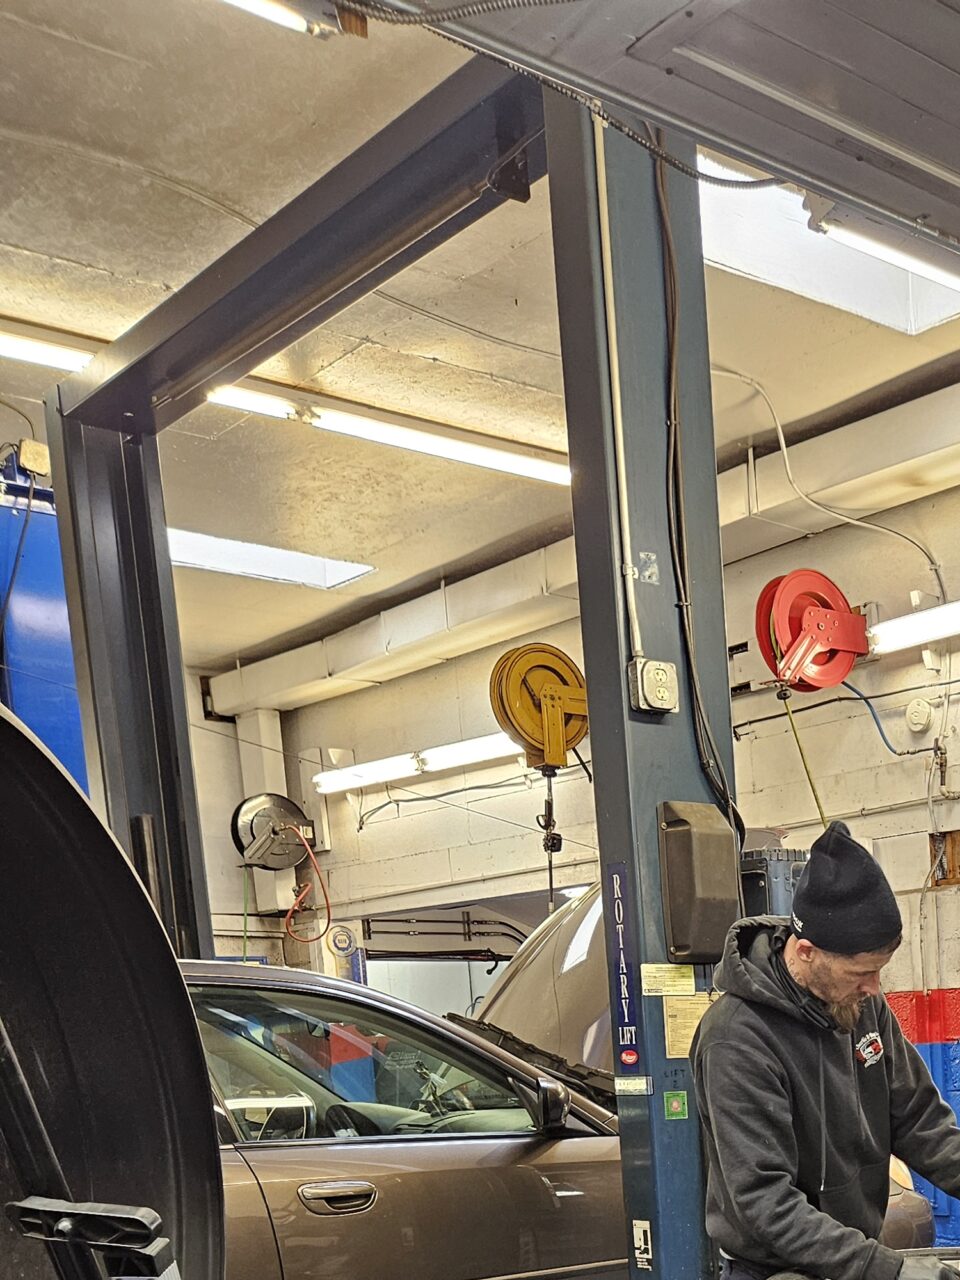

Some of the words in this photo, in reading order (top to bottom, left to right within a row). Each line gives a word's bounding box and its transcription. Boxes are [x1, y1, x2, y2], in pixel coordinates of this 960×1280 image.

[612, 874, 630, 1023] ROTARY
[618, 1026, 637, 1045] LIFT
[664, 1069, 686, 1079] LIFT
